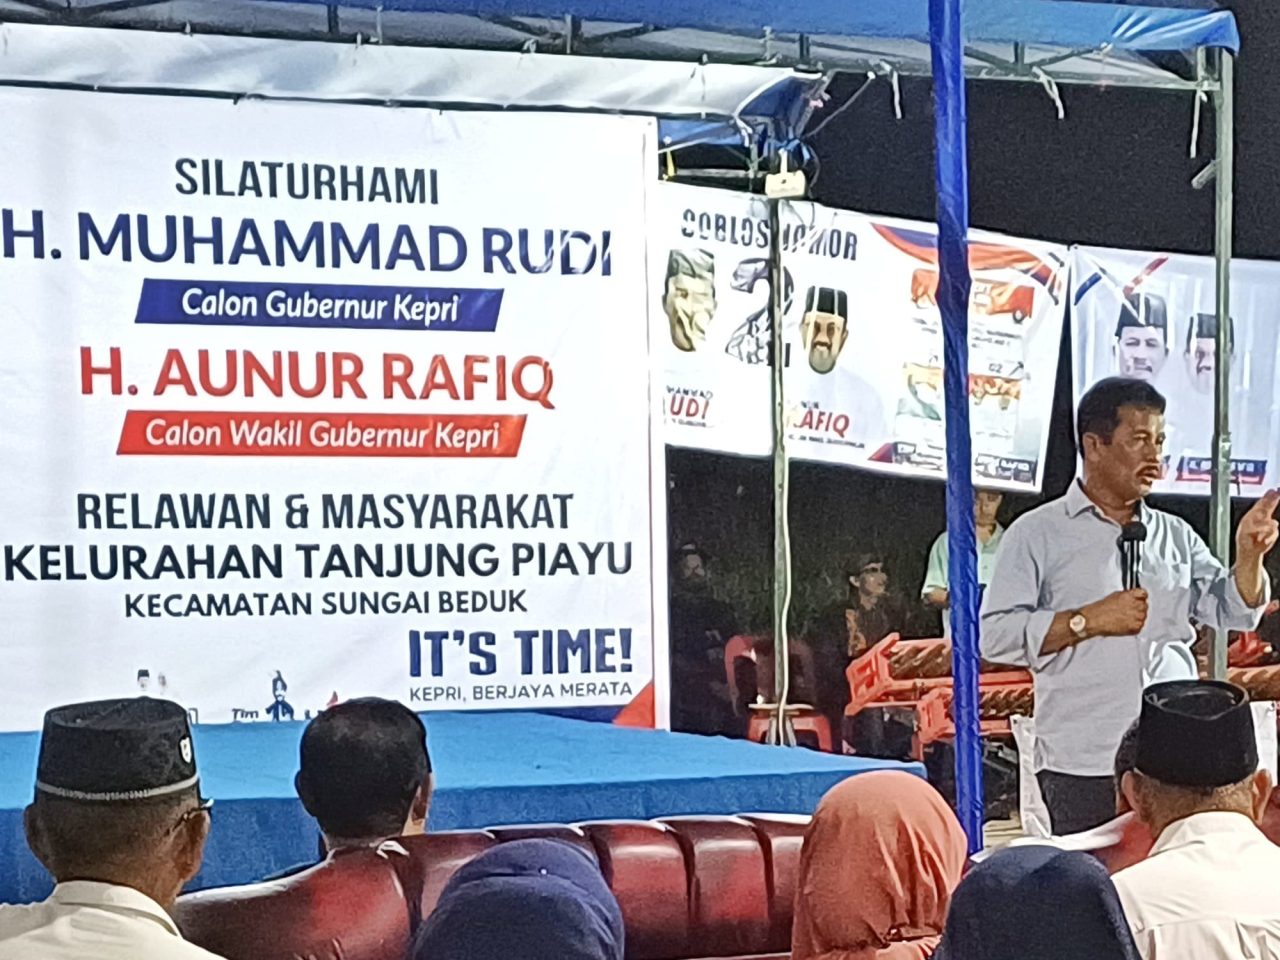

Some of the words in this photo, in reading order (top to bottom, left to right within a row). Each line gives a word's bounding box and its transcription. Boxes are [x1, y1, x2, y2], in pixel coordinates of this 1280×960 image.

[175, 157, 438, 204] SILATURHAMI
[2, 208, 61, 259] H.
[78, 211, 468, 272] MUHAMMAD
[482, 227, 611, 276] RUDI
[182, 288, 257, 317] Calon
[265, 290, 388, 320] Gubernur
[393, 292, 459, 328] Kepri
[80, 346, 138, 396] H.
[153, 348, 368, 399] AUNUR
[383, 352, 556, 409] RAFIQ
[145, 418, 221, 446] Calon
[229, 417, 303, 447] Wakil
[309, 419, 429, 448] Gubernur
[435, 421, 499, 453] Kepri
[786, 408, 850, 438] AFIQ
[77, 493, 271, 529] RELAWAN
[285, 493, 309, 529] &
[322, 493, 574, 529] MASYARAKAT
[3, 543, 283, 581] KELURAHAN
[295, 543, 500, 578] TANJUNG
[511, 541, 633, 576] PIAYU
[124, 592, 312, 618] KECAMATAN
[321, 590, 430, 615] SUNGAI
[438, 589, 528, 613] BEDUK
[409, 629, 498, 677] IT'S
[513, 628, 633, 675] TIME!
[410, 686, 466, 702] KEPRI,
[472, 684, 555, 701] BERJAYA
[560, 681, 633, 697] MERATA
